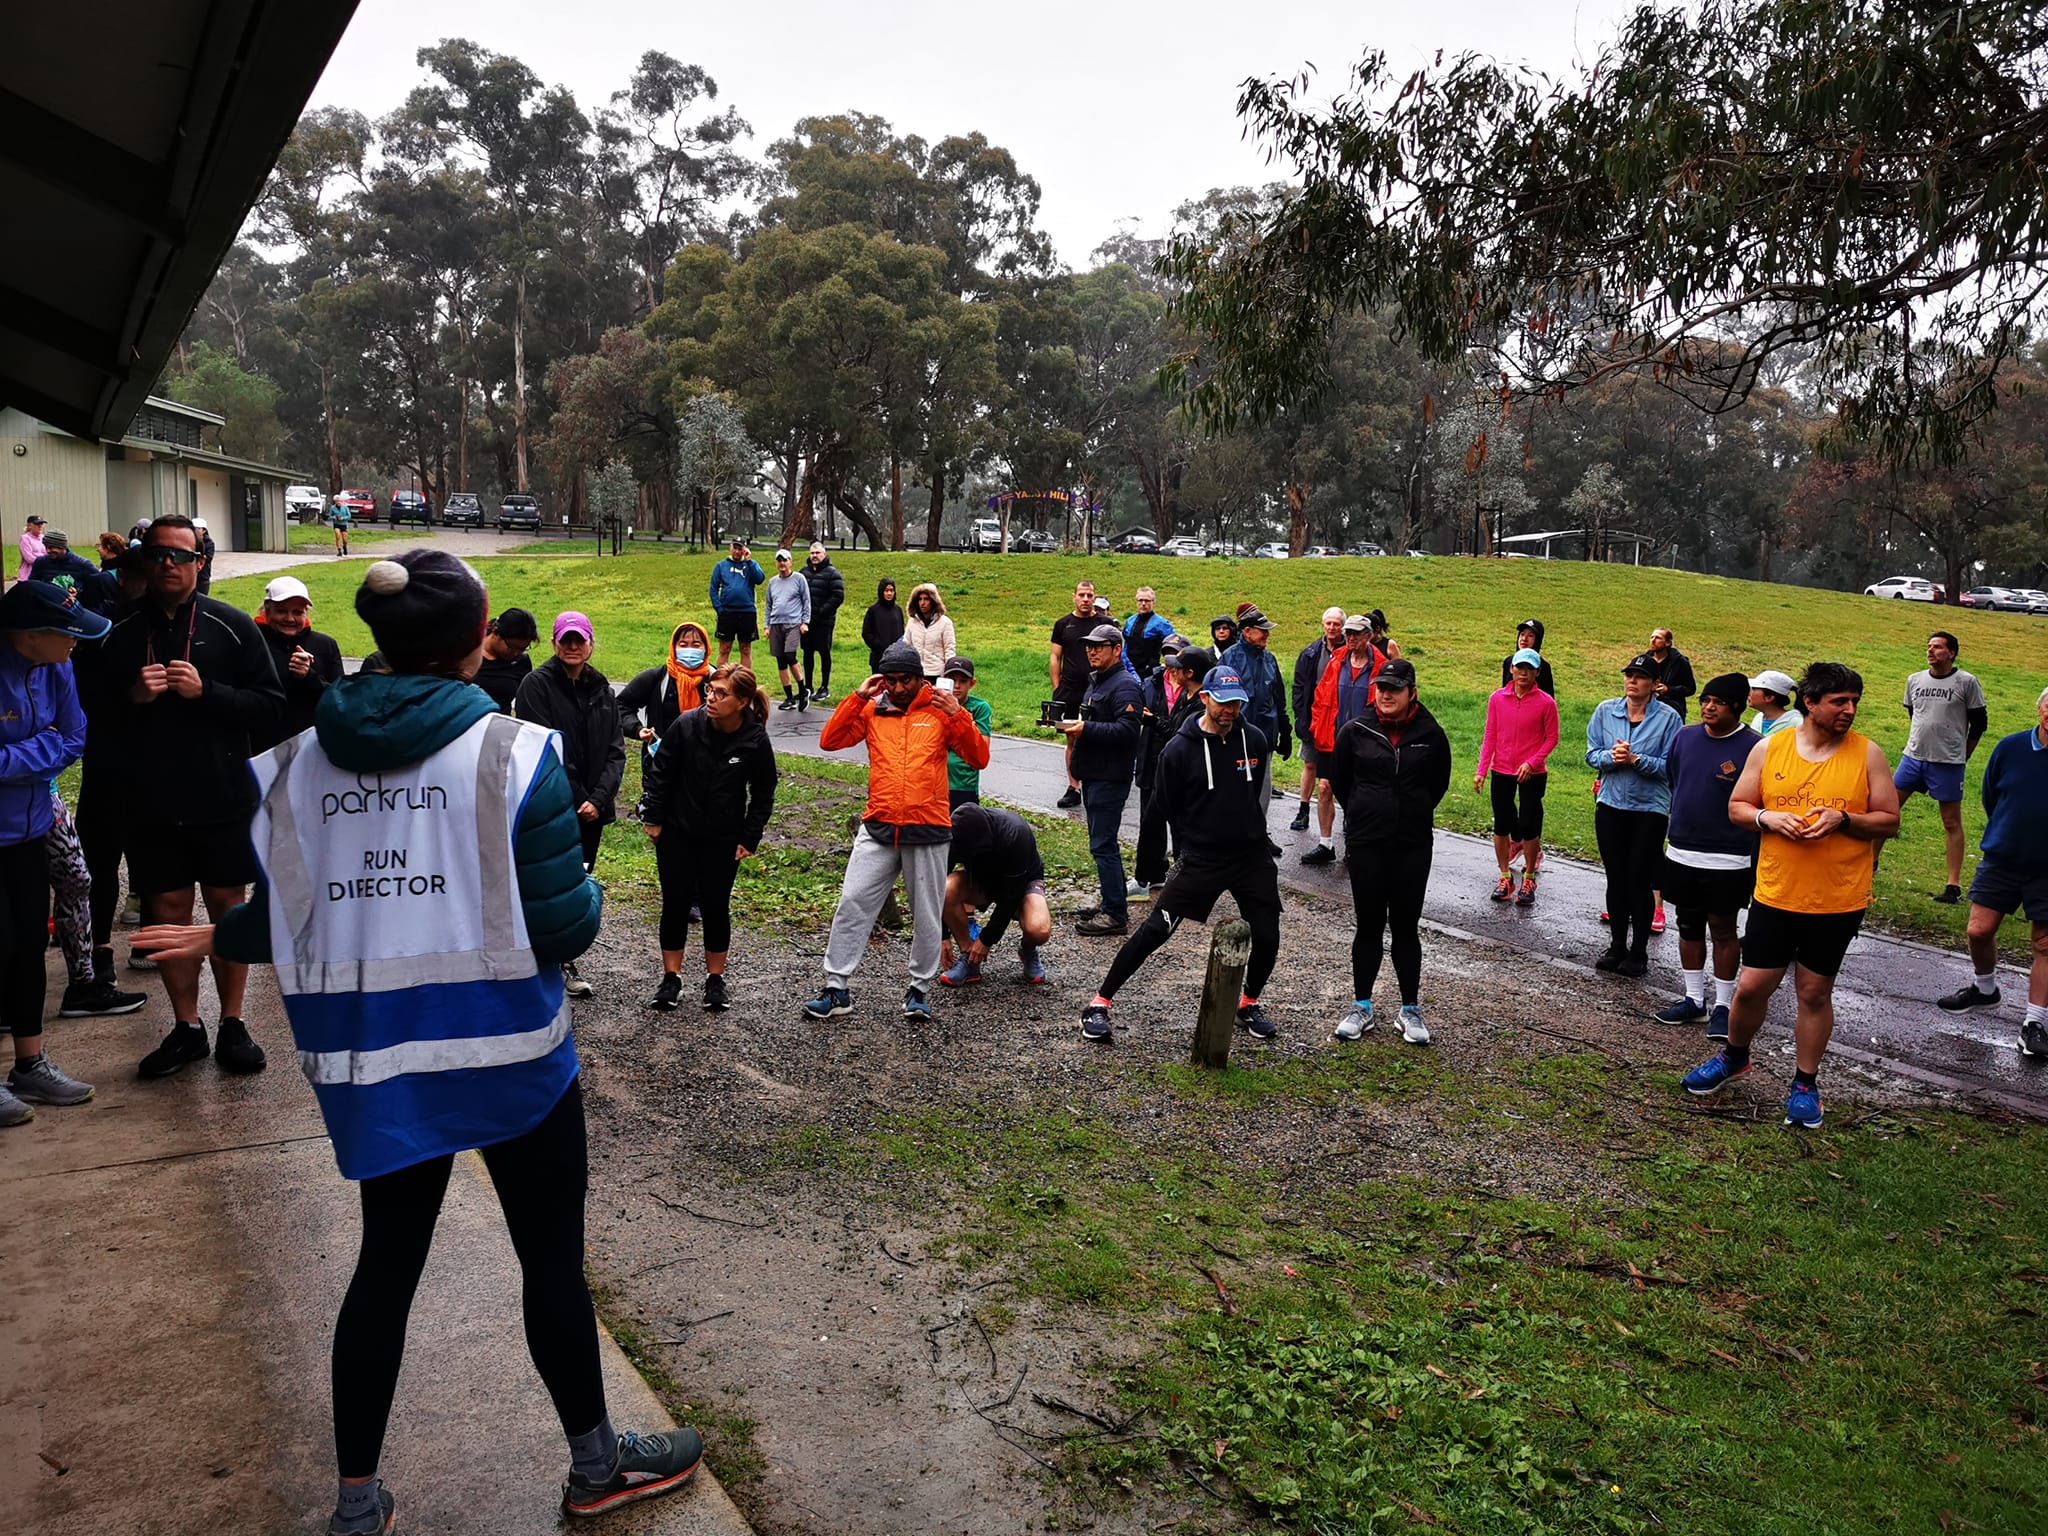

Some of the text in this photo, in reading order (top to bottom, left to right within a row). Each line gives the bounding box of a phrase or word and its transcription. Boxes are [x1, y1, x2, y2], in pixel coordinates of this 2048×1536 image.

[1913, 687, 1955, 702] SAUCONY
[321, 773, 447, 825] parkrun
[1776, 790, 1847, 809] parkrun
[363, 849, 407, 871] RUN
[328, 874, 446, 902] DIRECTOR
